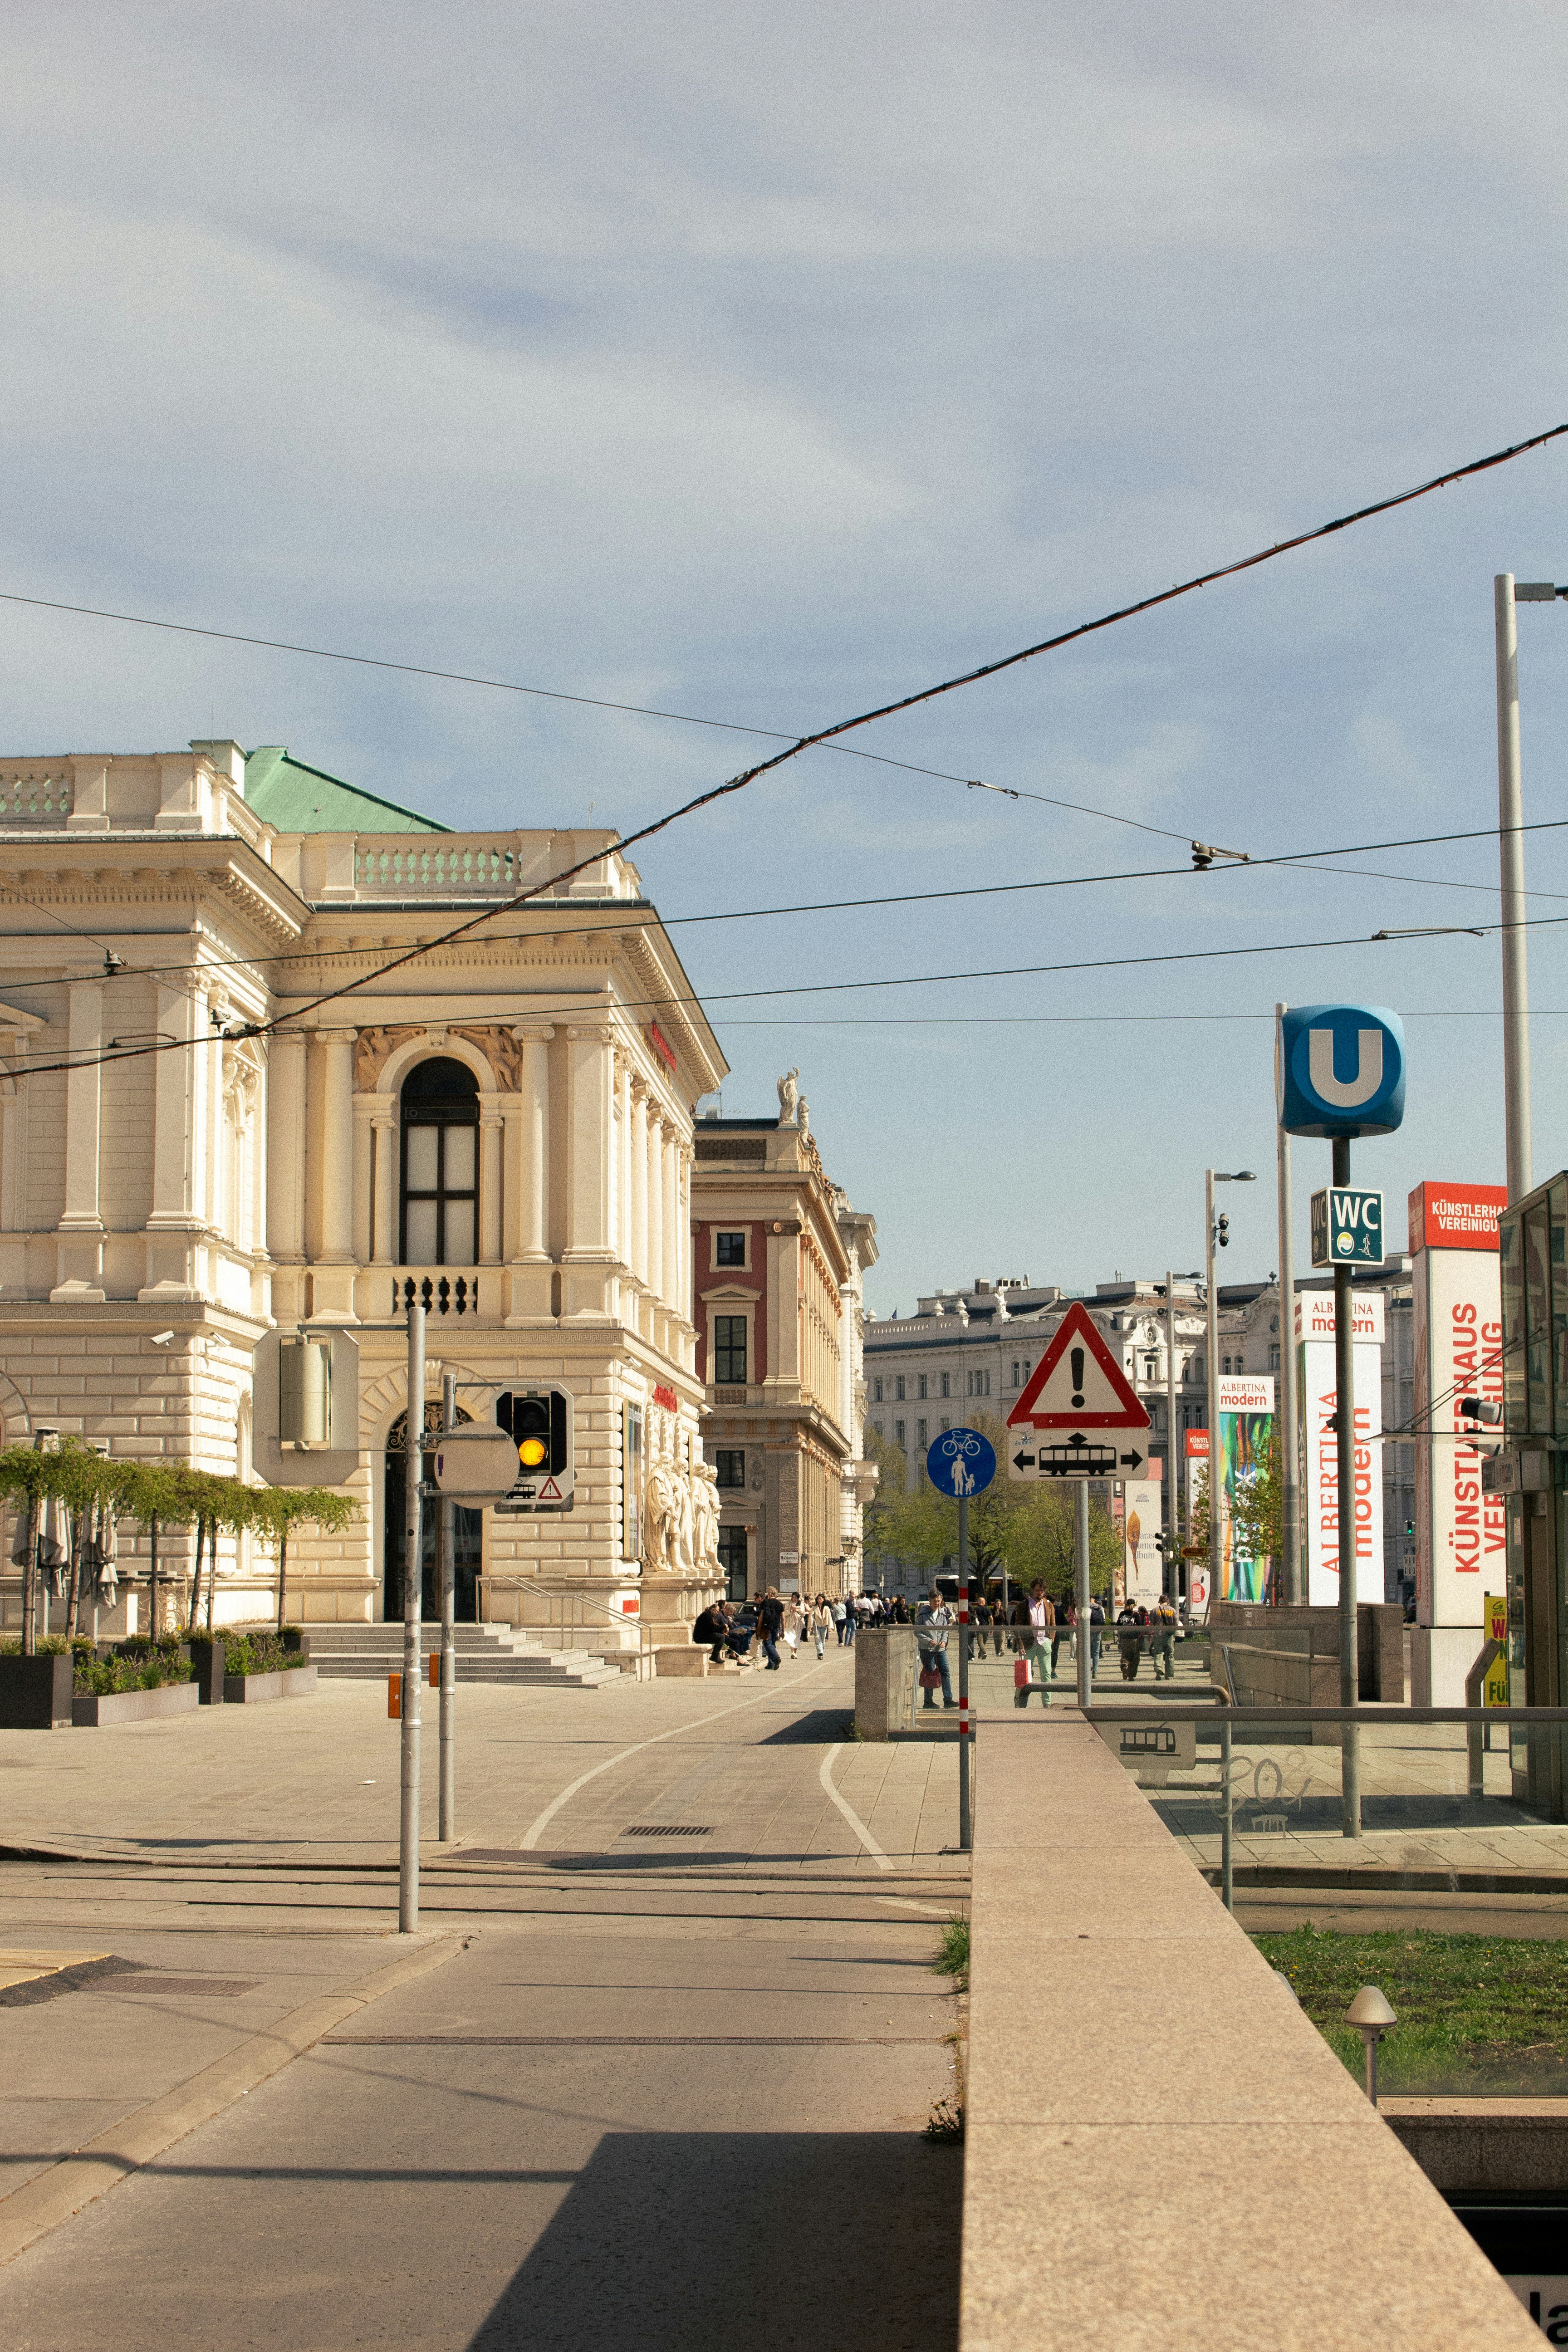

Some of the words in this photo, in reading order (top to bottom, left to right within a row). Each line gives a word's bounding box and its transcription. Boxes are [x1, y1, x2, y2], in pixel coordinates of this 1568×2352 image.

[1309, 1029, 1383, 1107] U
[1333, 1195, 1379, 1230] WC
[1431, 1199, 1507, 1218] KÜNSTLERHA
[1438, 1216, 1498, 1233] VEREINIGU
[1312, 1301, 1373, 1314] ALBINA
[1312, 1318, 1374, 1333] moern
[1221, 1382, 1266, 1393] ALBERTINA
[1220, 1393, 1267, 1406] modern
[1489, 1681, 1508, 1702] FÜ
